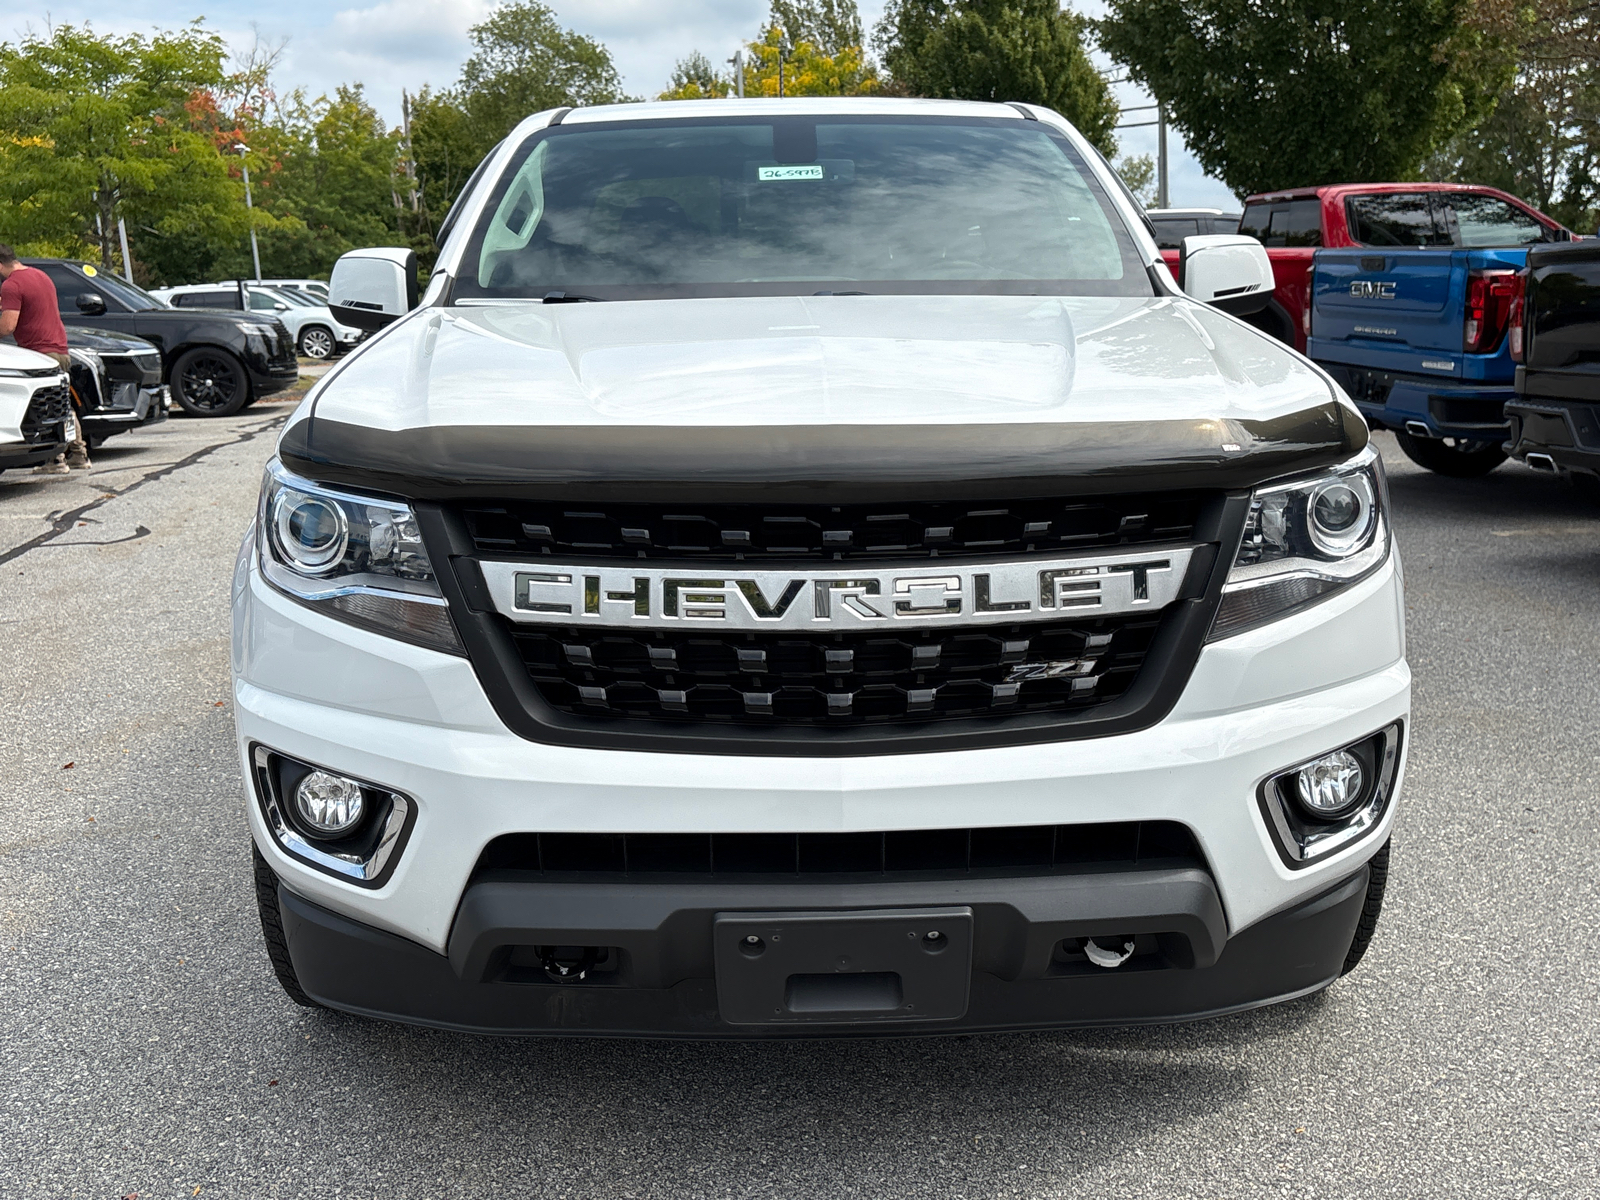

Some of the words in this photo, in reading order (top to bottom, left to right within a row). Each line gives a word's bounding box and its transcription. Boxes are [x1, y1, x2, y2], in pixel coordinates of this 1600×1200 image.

[1350, 280, 1396, 299] GMC
[512, 559, 1170, 620] CHEVROLET
[1003, 658, 1098, 682] Z71
